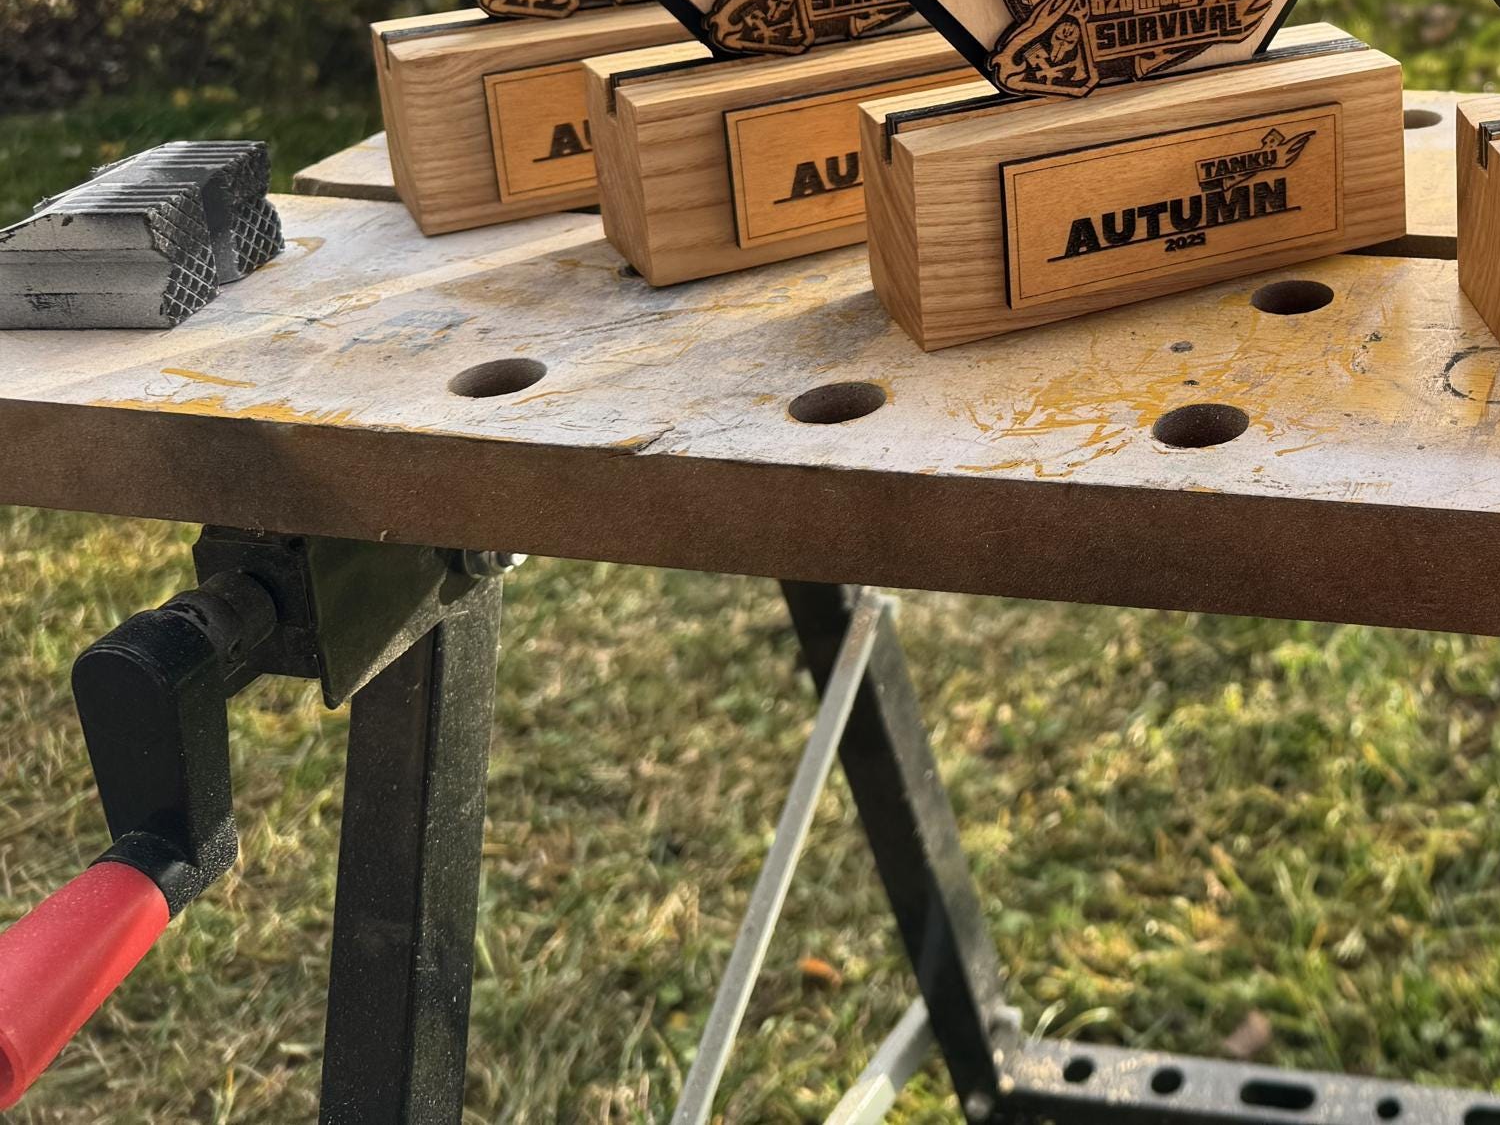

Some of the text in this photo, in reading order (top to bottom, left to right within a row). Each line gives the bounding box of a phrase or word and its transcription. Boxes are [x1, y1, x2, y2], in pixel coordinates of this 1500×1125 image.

[1095, 3, 1242, 50] SURVIVAL
[1200, 149, 1278, 179] TANKU
[1064, 177, 1287, 257] AUTUMN
[1164, 232, 1206, 252] 2025
